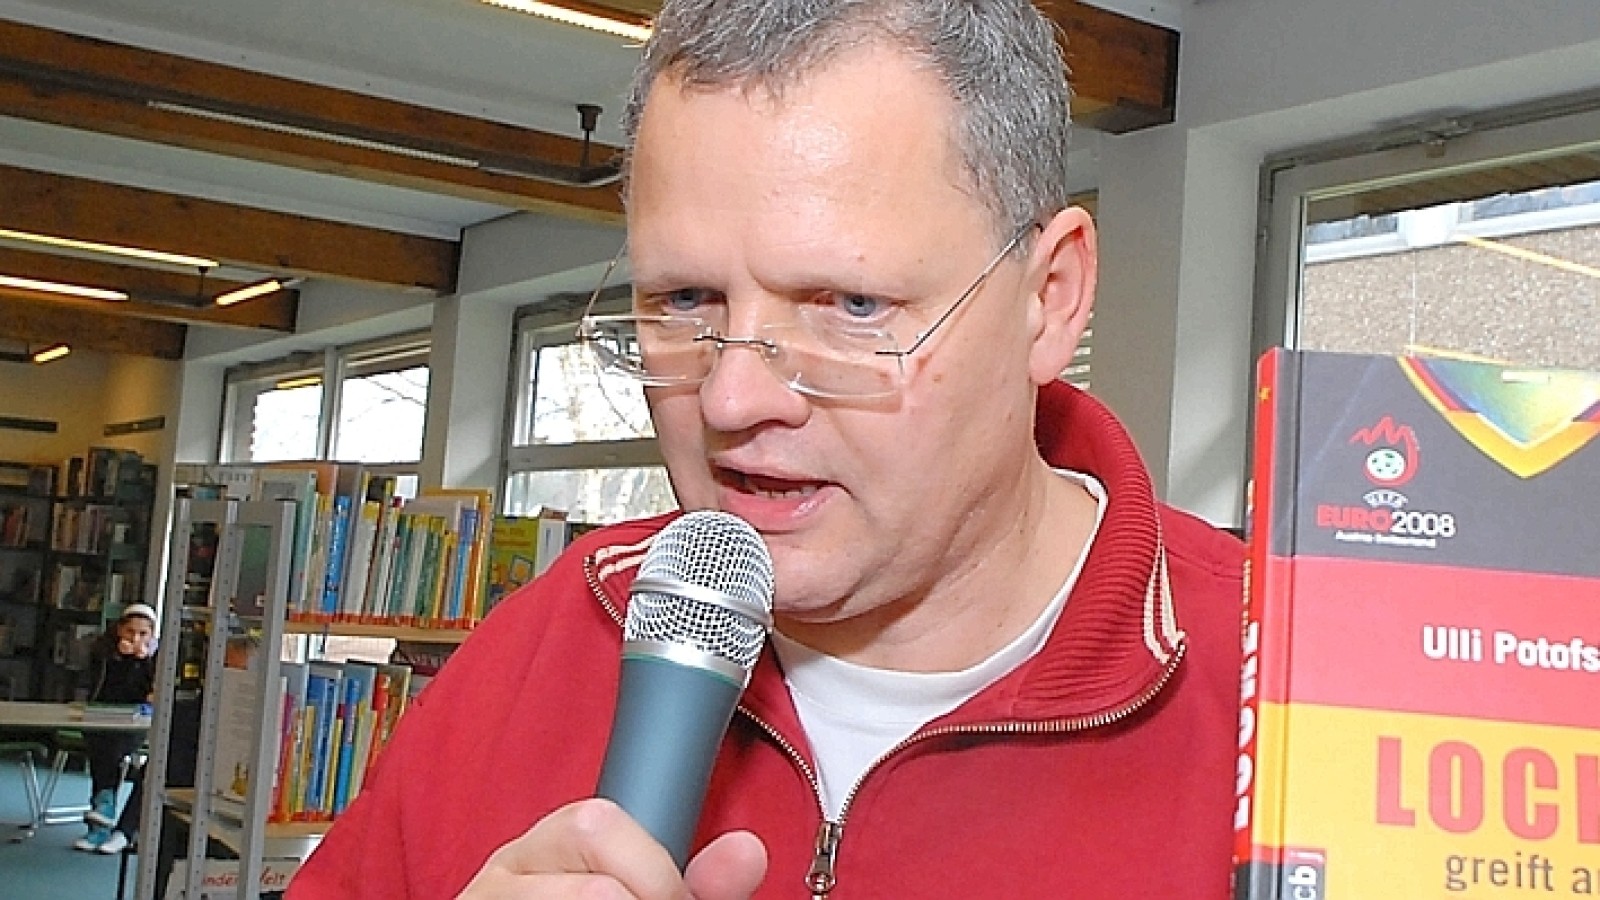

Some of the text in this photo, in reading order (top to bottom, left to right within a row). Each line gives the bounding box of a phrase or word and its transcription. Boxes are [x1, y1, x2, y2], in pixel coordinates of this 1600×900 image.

[1422, 624, 1483, 663] Ulli
[1445, 851, 1600, 895] greift a
